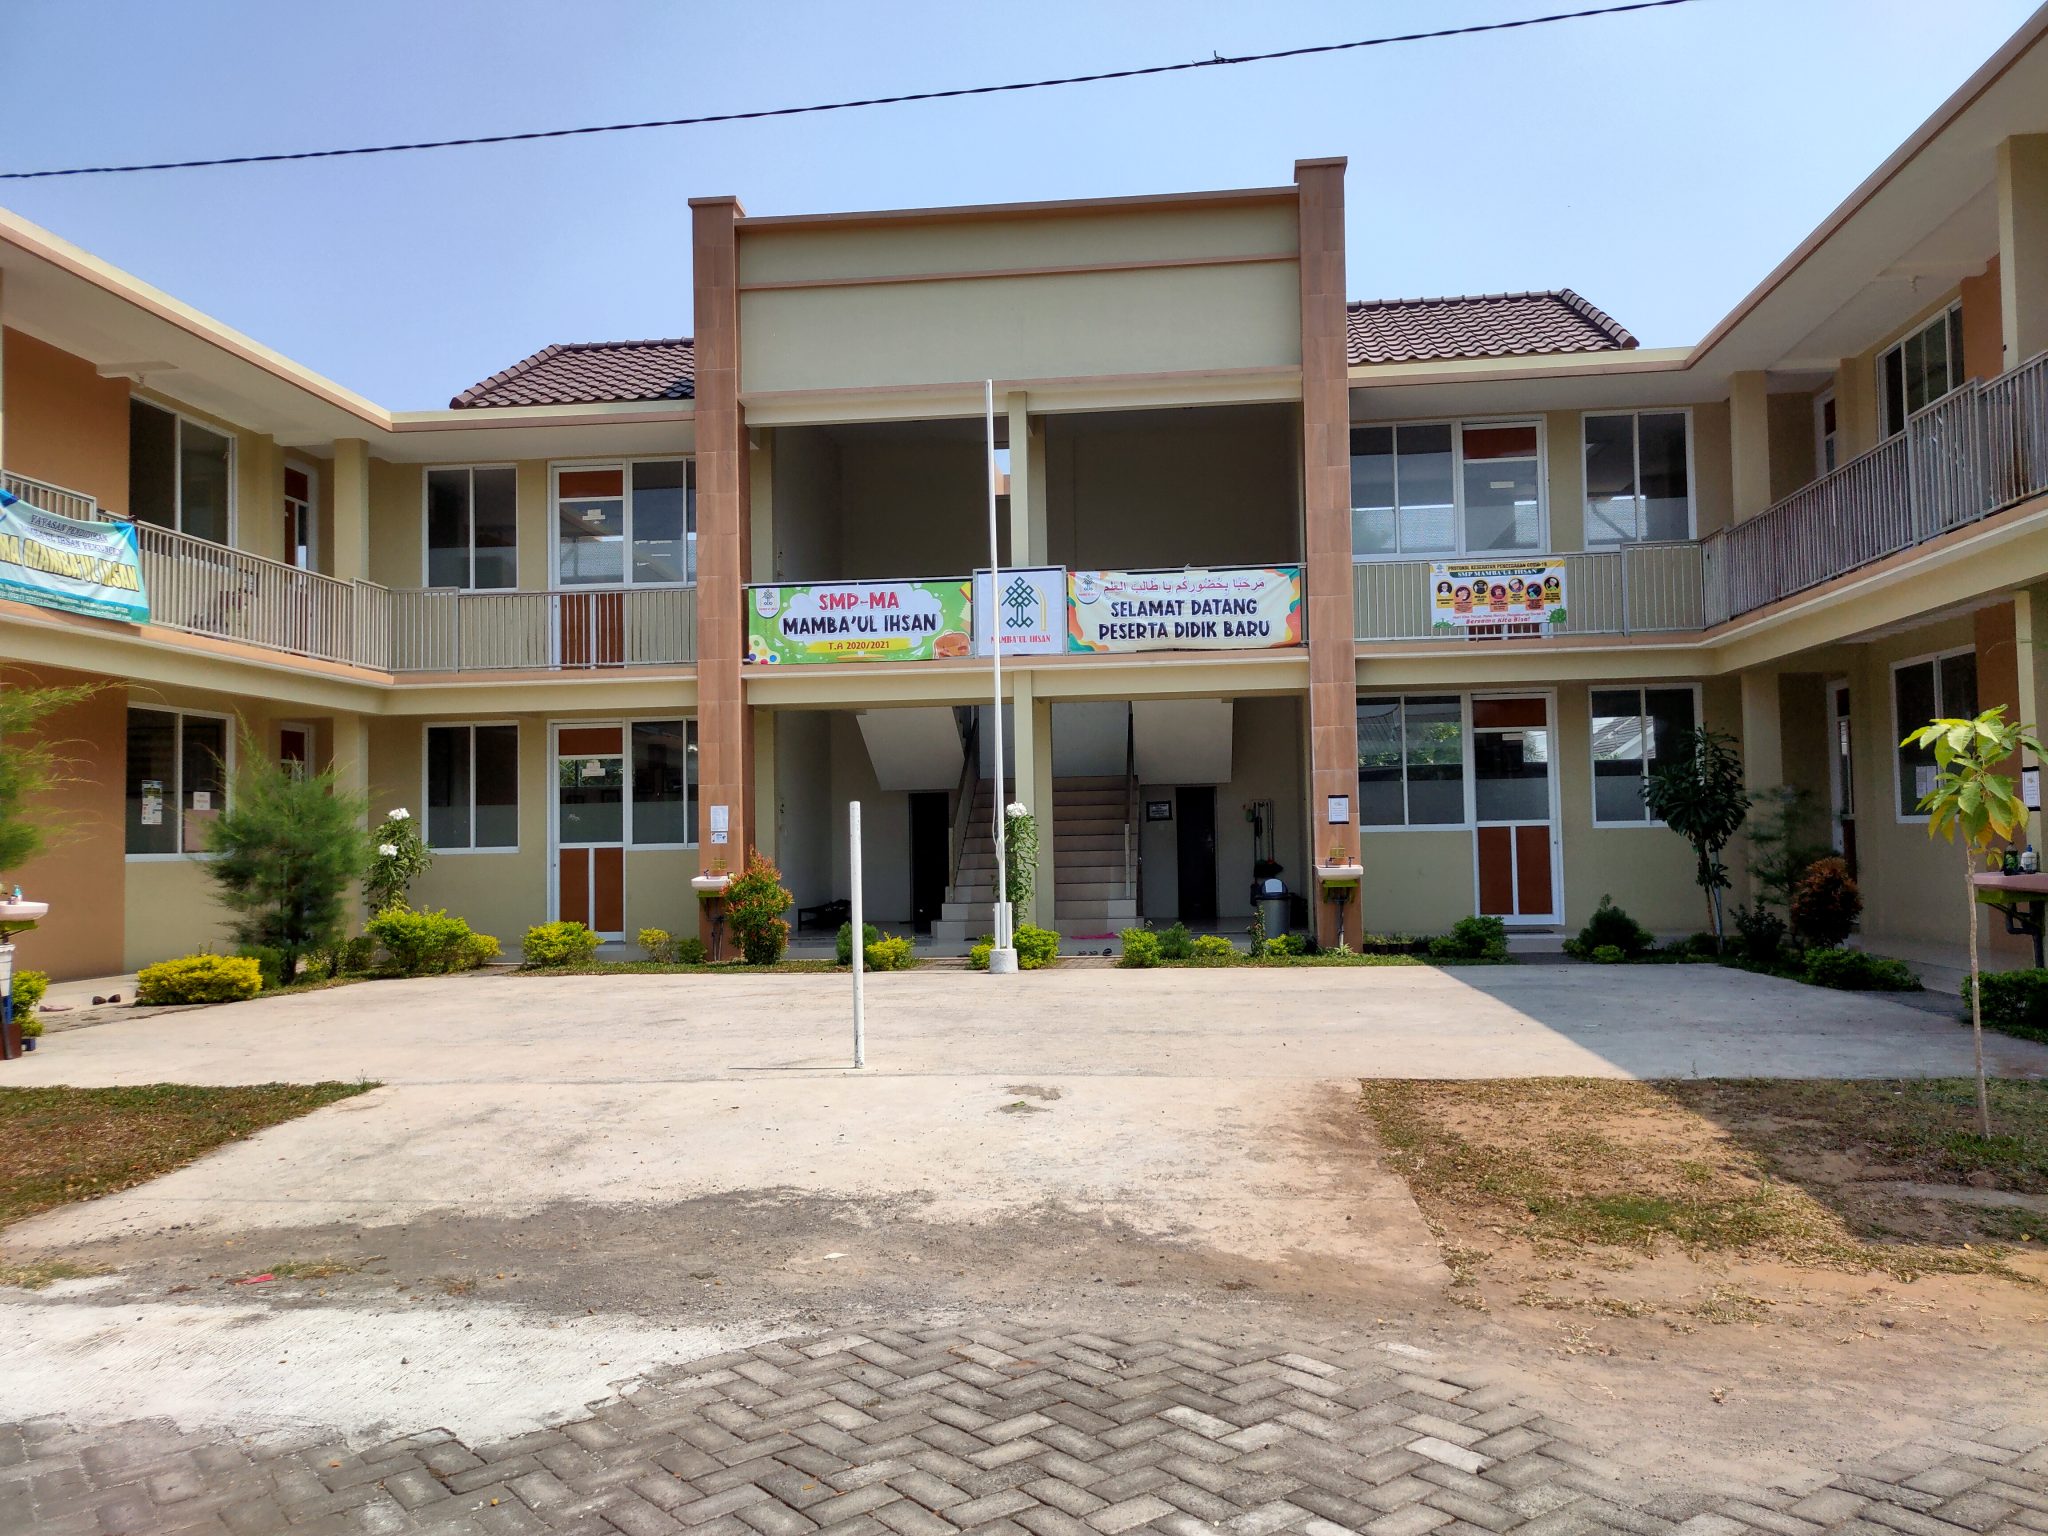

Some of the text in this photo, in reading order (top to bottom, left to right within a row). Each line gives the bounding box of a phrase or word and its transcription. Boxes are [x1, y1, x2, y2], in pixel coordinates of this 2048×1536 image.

[818, 591, 900, 611] SMP-MA
[1110, 598, 1257, 617] SELAMAT DATANG
[783, 613, 937, 635] MAMBA'UL IHSAN
[1098, 620, 1270, 640] PESERTA DIDIK BARU
[828, 640, 890, 650] T.A 2020/2021
[1029, 634, 1051, 643] IHSAN
